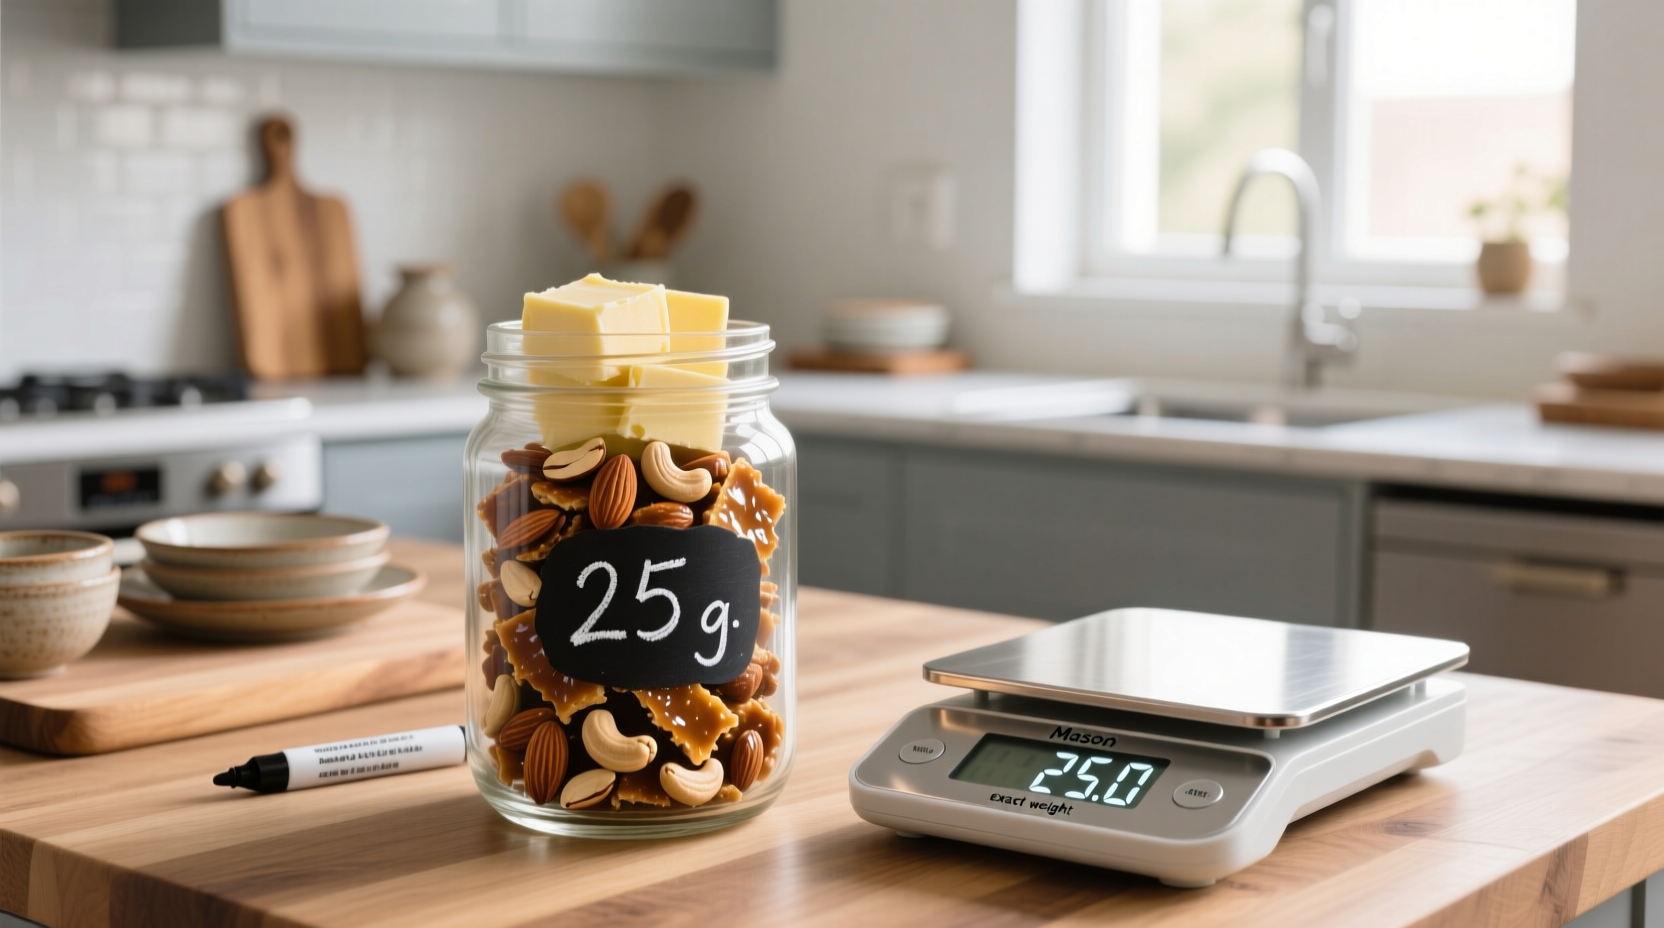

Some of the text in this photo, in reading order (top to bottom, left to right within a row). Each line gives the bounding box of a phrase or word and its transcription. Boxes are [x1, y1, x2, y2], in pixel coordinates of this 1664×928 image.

[569, 557, 740, 667] 25 g.
[1049, 726, 1117, 748] Mason
[1028, 751, 1155, 807] 25.0
[989, 793, 1075, 816] exact weight
